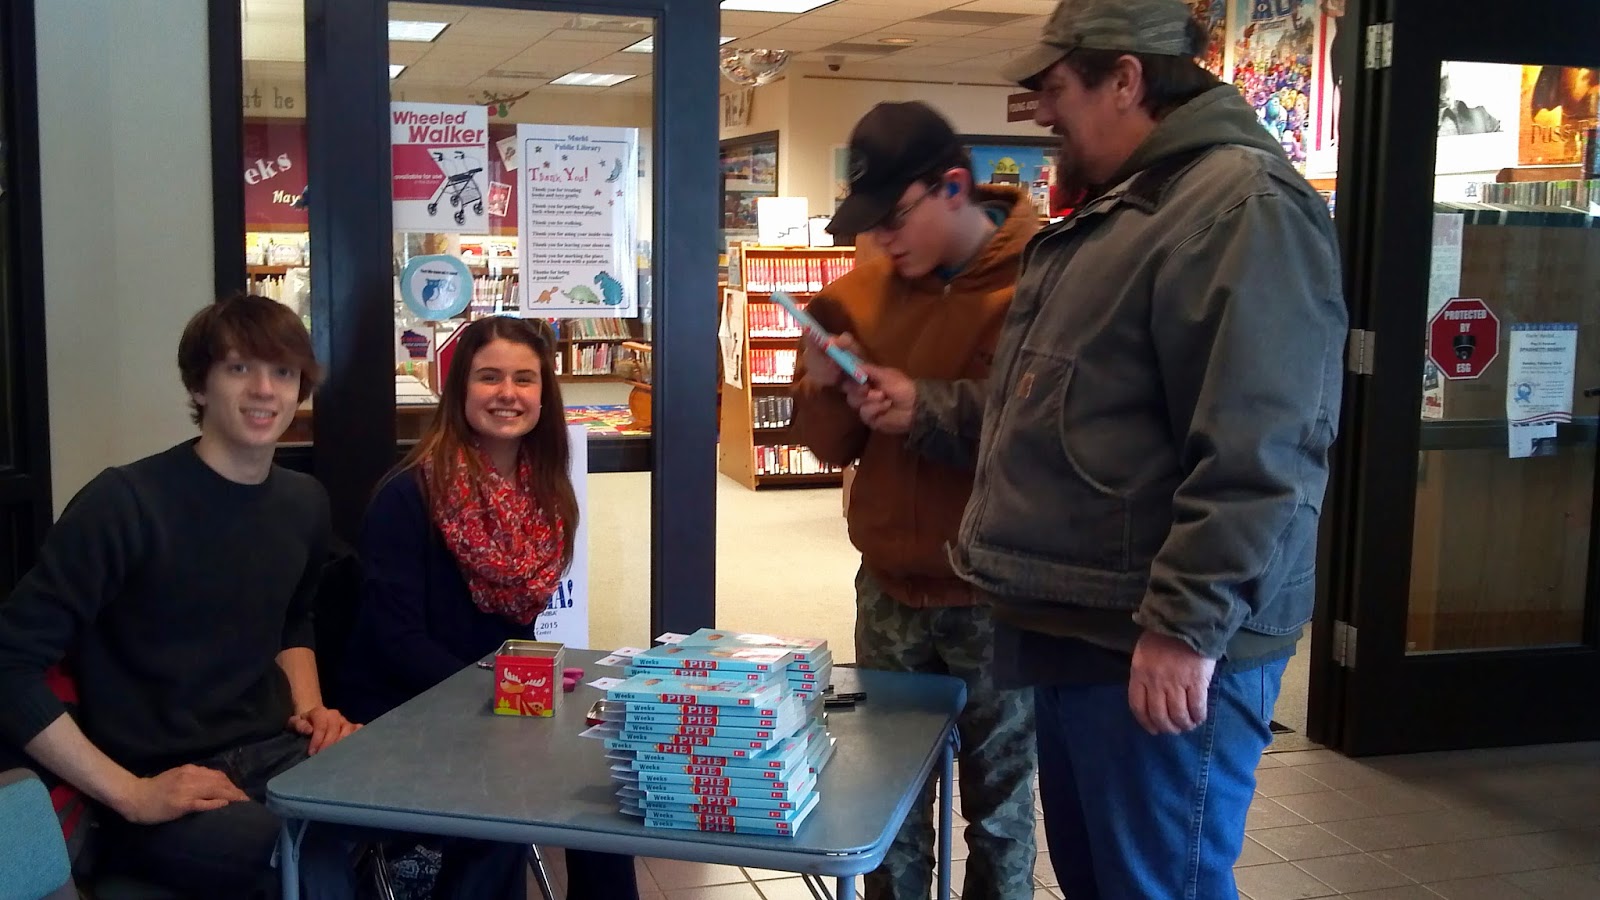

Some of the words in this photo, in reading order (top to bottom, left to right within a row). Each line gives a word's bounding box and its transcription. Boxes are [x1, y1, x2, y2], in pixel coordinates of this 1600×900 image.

[393, 111, 467, 125] Wheeled
[408, 126, 485, 143] Walker
[554, 143, 575, 151] Public
[576, 144, 602, 152] Library
[244, 153, 292, 185] eks
[272, 190, 301, 206] May
[1444, 310, 1487, 321] PROTECTED
[1459, 323, 1471, 333] BY
[1456, 363, 1472, 373] ESG
[540, 621, 558, 629] 2015
[689, 660, 713, 669] PIE
[666, 694, 692, 703] PIE
[687, 705, 713, 714] PIE
[687, 716, 712, 725] PIE
[685, 726, 710, 735] PIE
[679, 736, 704, 745] PIE
[663, 744, 688, 754] PIE
[697, 756, 722, 765] PIE
[692, 766, 717, 775] PIE
[700, 777, 725, 786] PIE
[699, 786, 724, 795] PIE
[707, 797, 732, 806] PIE
[698, 805, 723, 814] PIE
[705, 815, 730, 824] PIE
[705, 824, 731, 832] PIE
